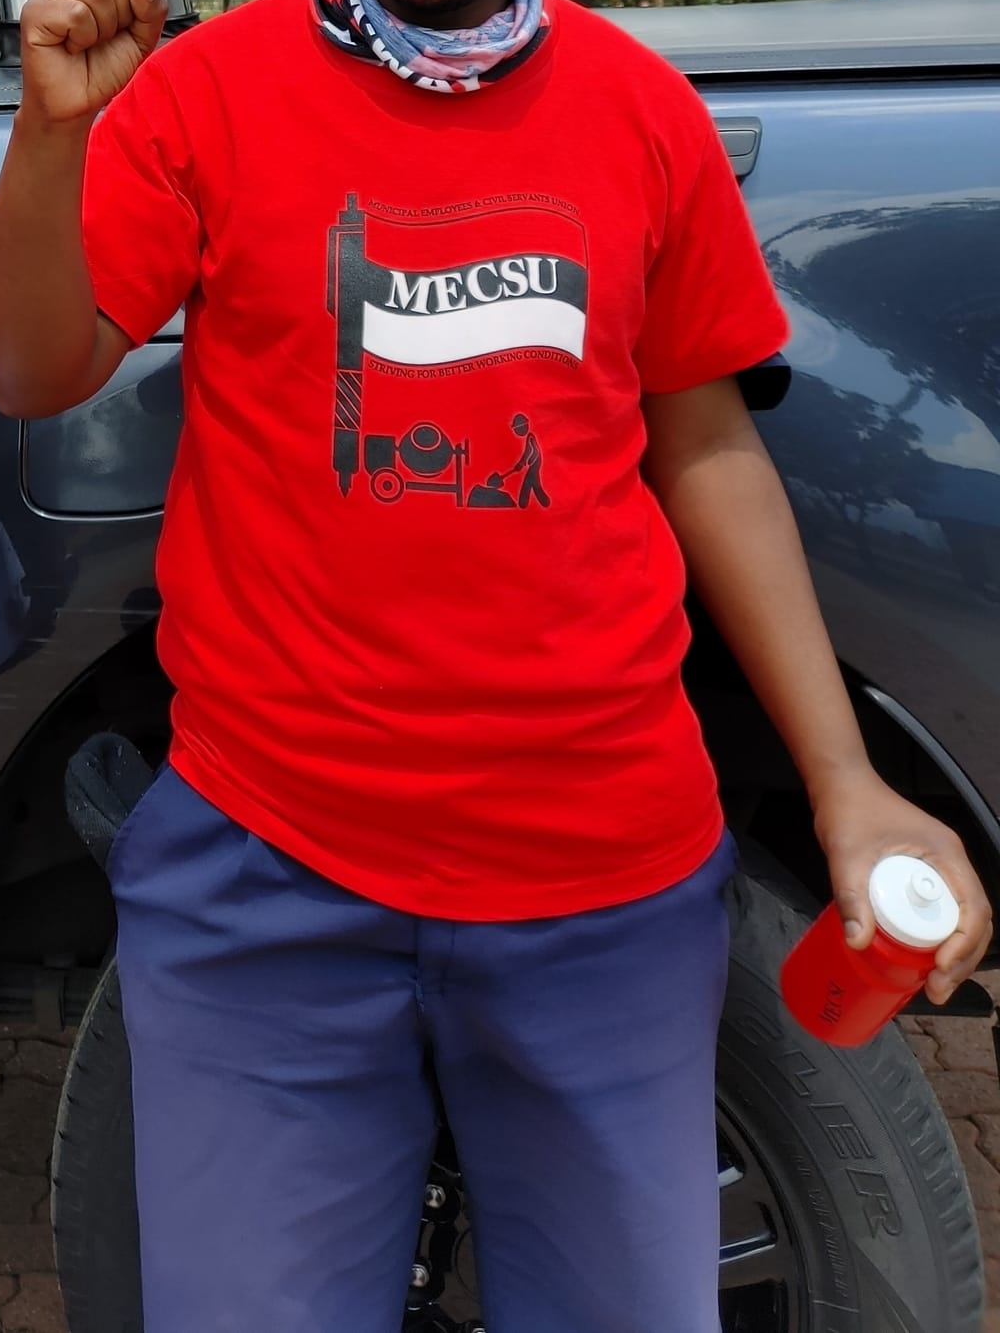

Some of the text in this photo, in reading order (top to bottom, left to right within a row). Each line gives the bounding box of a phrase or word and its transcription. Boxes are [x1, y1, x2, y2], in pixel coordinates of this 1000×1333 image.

[368, 198, 419, 217] MUNICIPAL
[421, 201, 472, 216] EMPLOYEES
[482, 195, 507, 206] CIVIL
[507, 193, 550, 203] SERVANTS
[551, 198, 580, 215] UNION
[385, 257, 559, 315] MECSU
[368, 349, 580, 378] STRIVING FOR BETTER WORKING CONDITIONS
